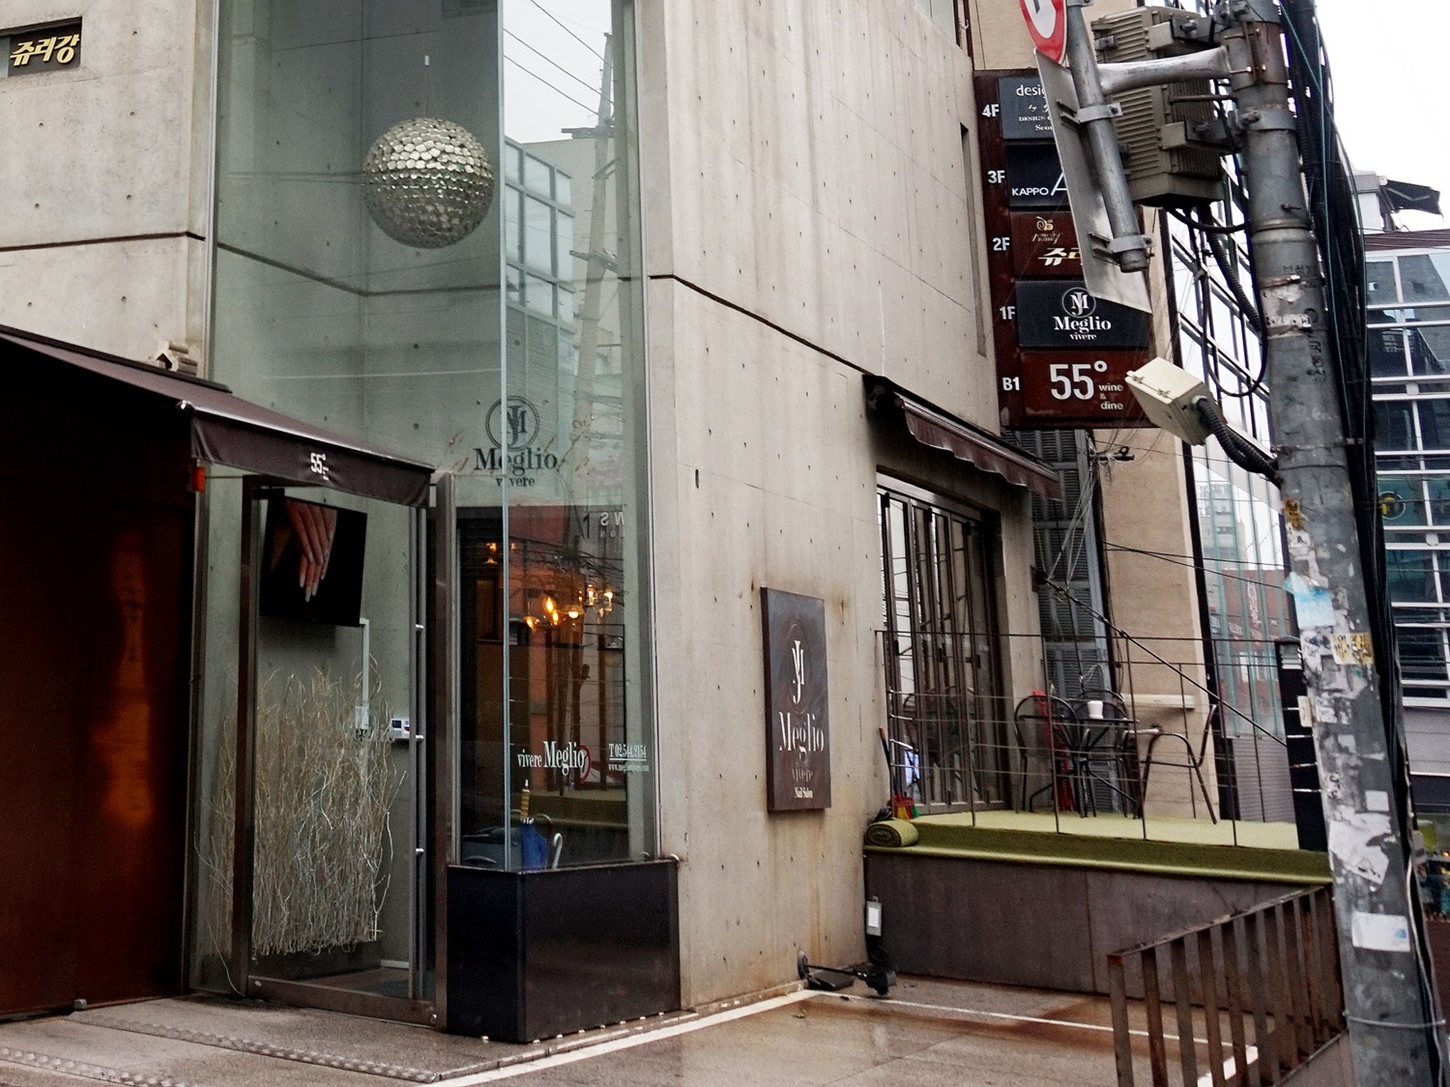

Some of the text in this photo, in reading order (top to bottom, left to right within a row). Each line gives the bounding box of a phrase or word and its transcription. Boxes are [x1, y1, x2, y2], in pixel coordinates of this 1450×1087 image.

[982, 104, 1000, 118] 4F
[987, 170, 1005, 184] 3F
[1011, 187, 1049, 197] KAPPO
[992, 237, 1010, 251] 2F
[999, 306, 1016, 320] 1F
[1053, 316, 1111, 335] Meglio
[1070, 333, 1097, 341] vivere
[1002, 376, 1020, 391] B1
[1098, 383, 1124, 392] wine
[1101, 402, 1124, 410] dine
[473, 447, 558, 476] Meglio
[496, 476, 536, 488] vvere
[779, 711, 825, 763] Meglio
[517, 749, 542, 768] vivere
[543, 741, 586, 776] Meglio
